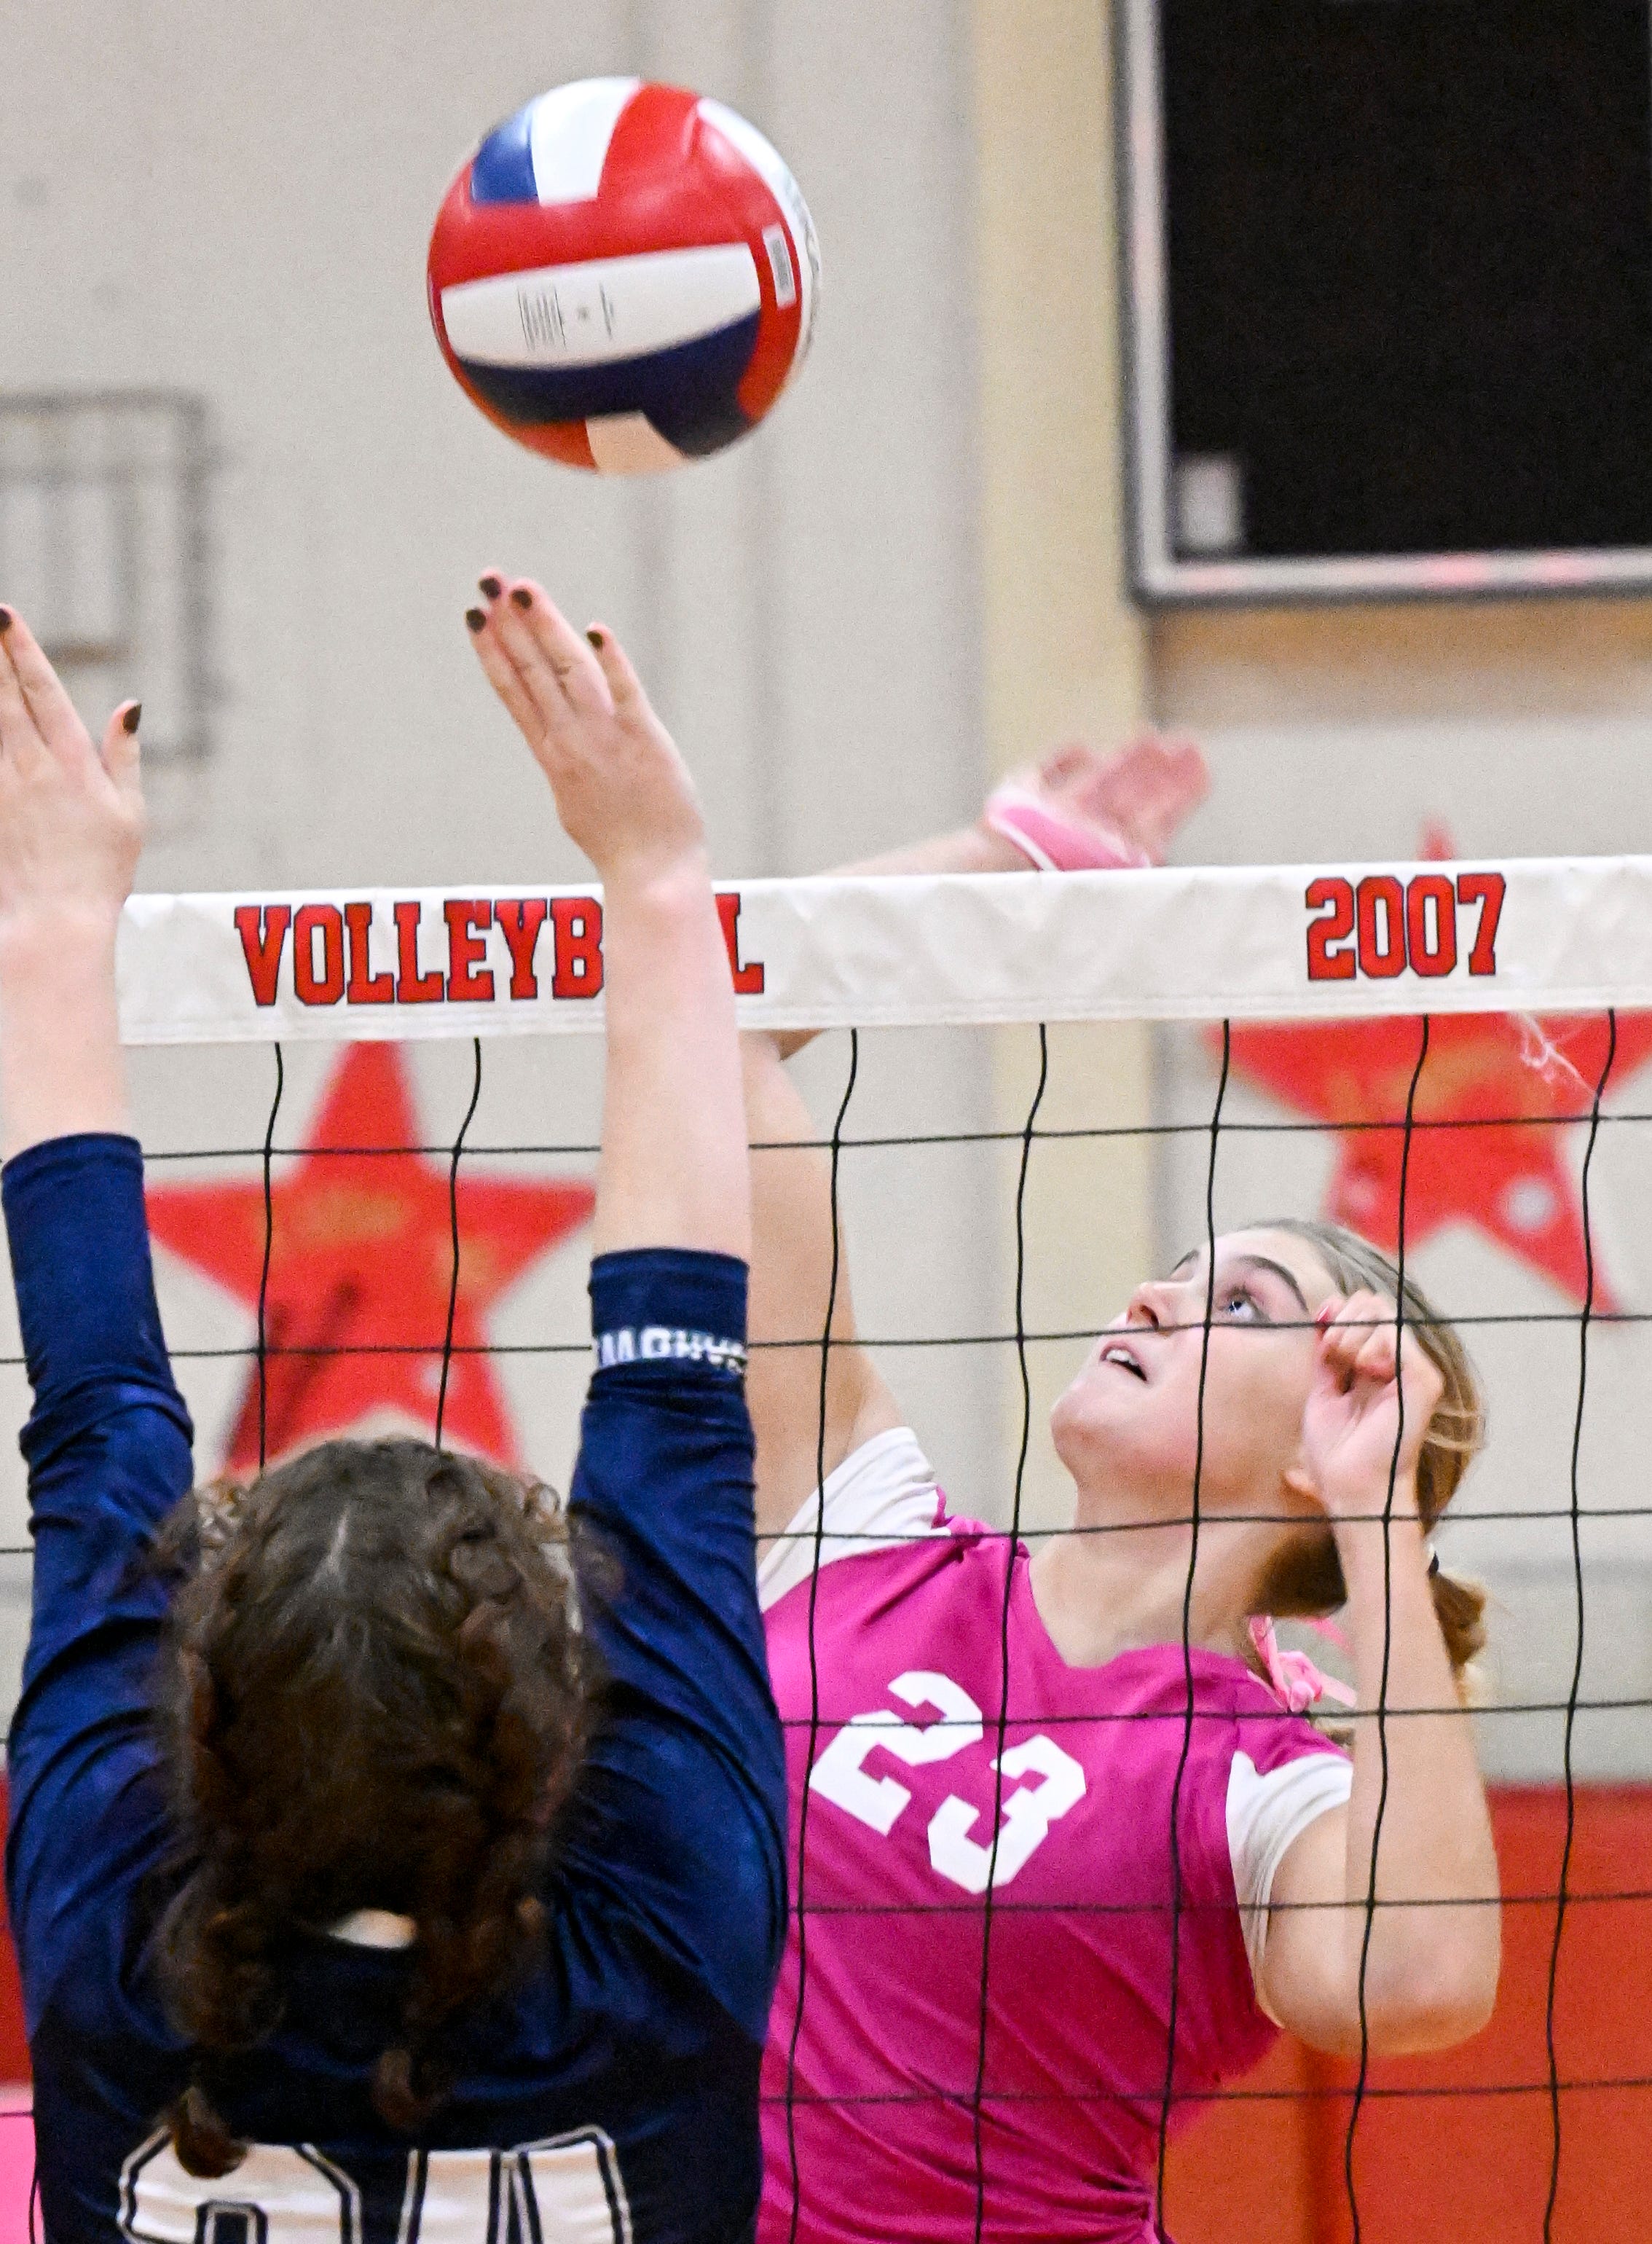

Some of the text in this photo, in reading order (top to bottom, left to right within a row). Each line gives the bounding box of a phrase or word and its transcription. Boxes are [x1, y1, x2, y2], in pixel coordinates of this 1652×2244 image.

[234, 892, 765, 1006] VOLLEYBL
[1305, 872, 1507, 981] 2007
[809, 1670, 1087, 1894] 23
